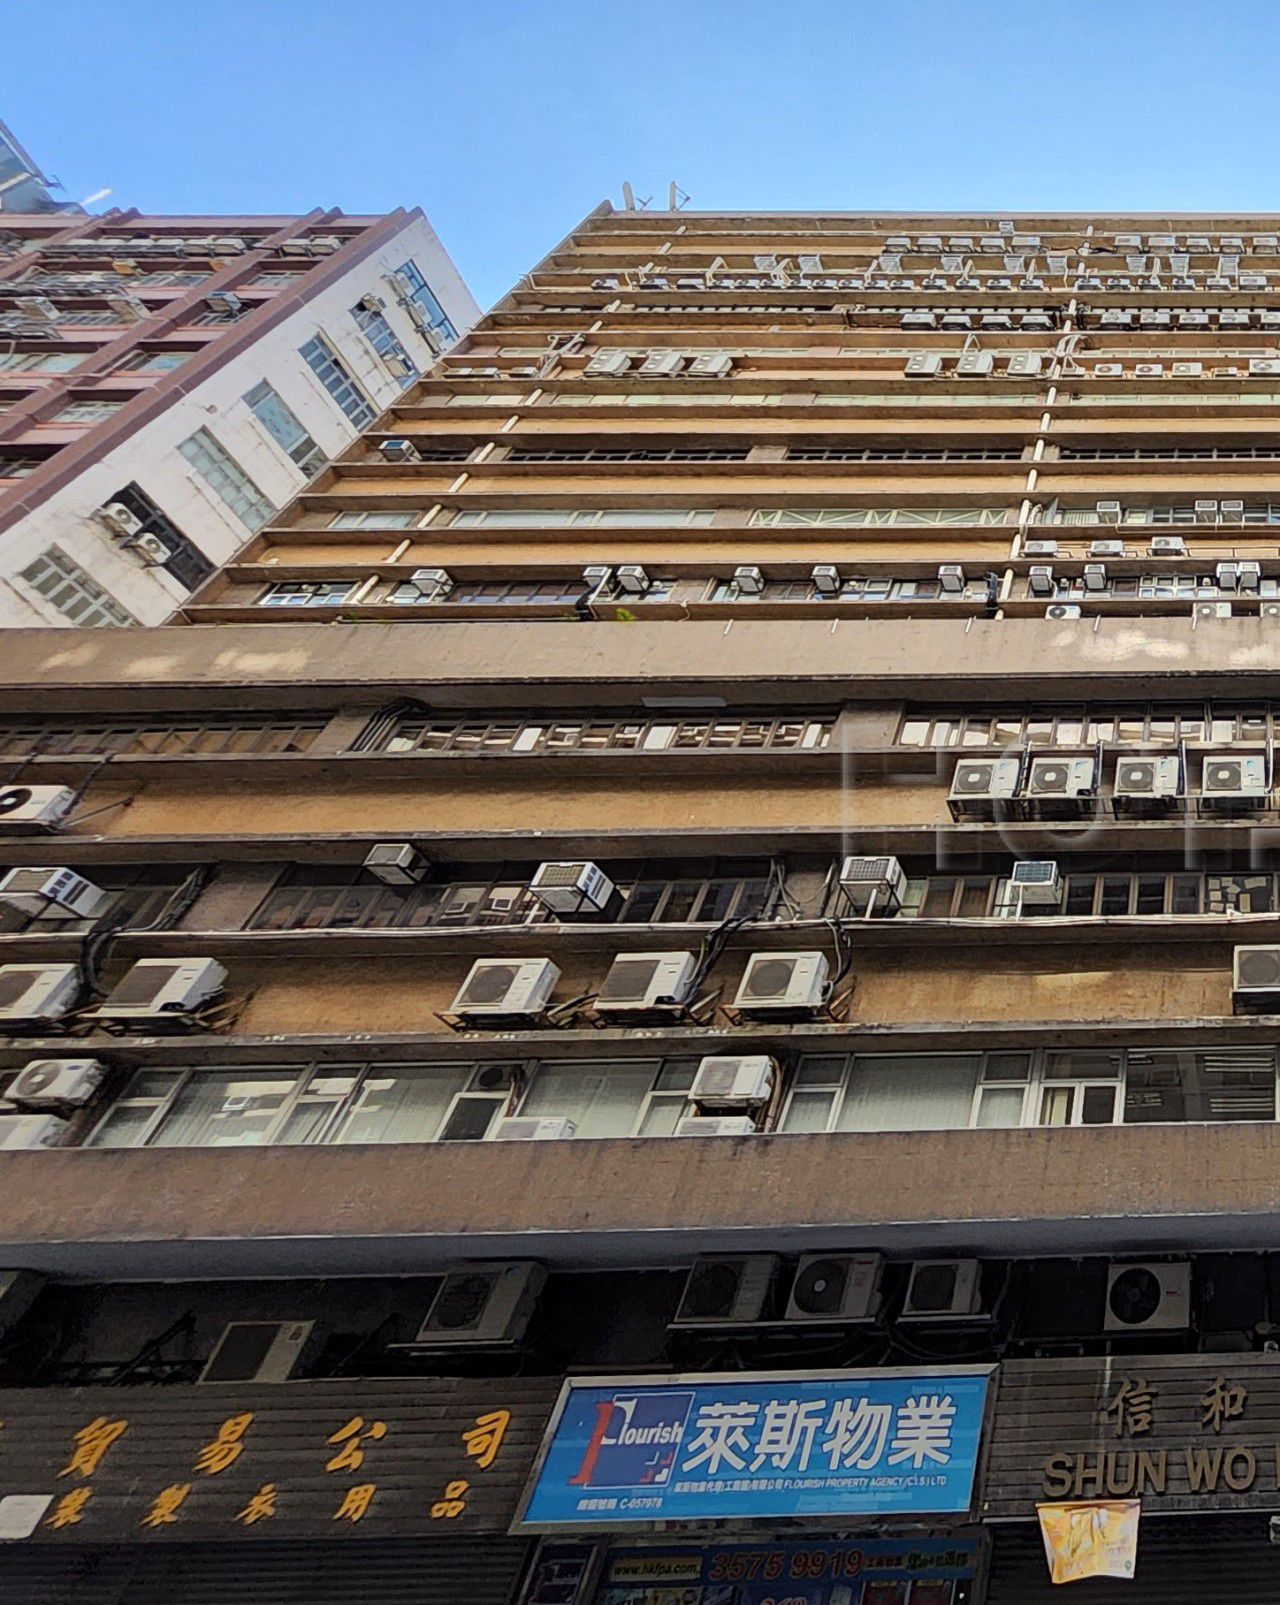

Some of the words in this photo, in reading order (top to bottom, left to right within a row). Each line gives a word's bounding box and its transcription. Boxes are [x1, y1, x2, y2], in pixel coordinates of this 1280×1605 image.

[680, 1394, 958, 1475] 萊斯物業
[784, 1478, 826, 1489] FLOURISH
[826, 1477, 869, 1488] PROPERTY
[870, 1475, 904, 1487] AGENCY
[1042, 1449, 1167, 1499] SHUN
[1185, 1446, 1257, 1492] WO
[708, 1551, 785, 1582] 3575
[789, 1549, 865, 1580] 9919
